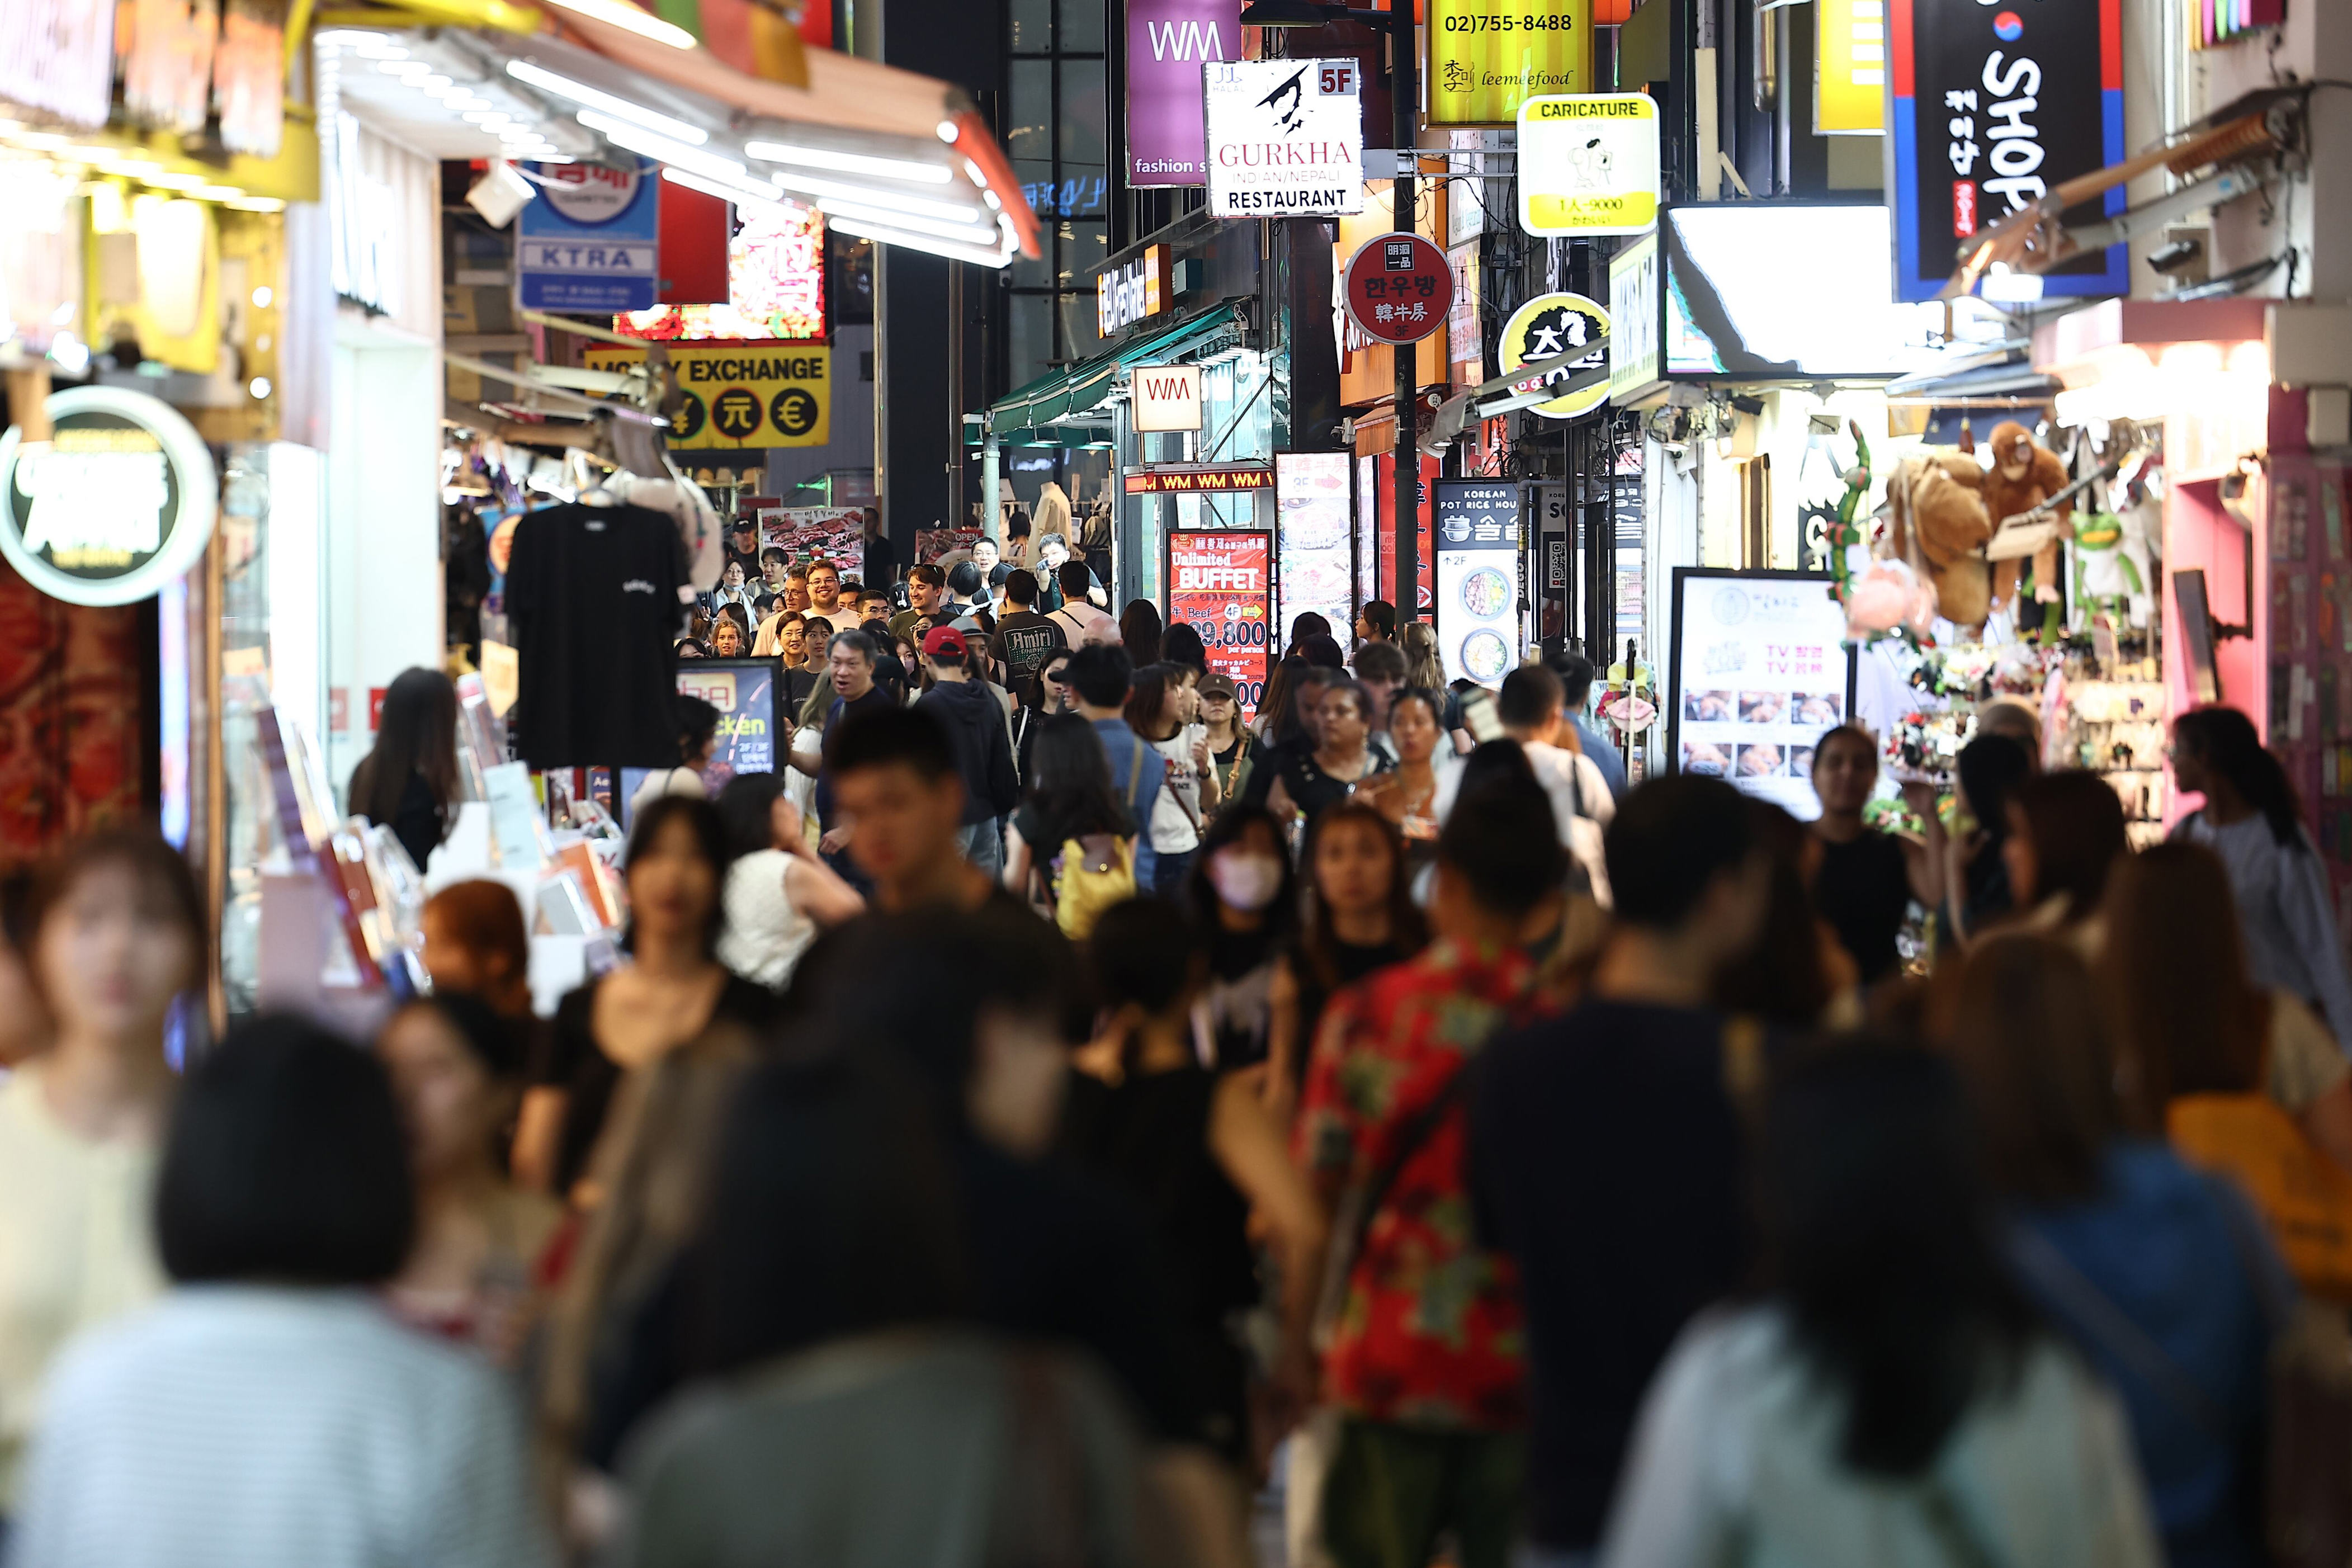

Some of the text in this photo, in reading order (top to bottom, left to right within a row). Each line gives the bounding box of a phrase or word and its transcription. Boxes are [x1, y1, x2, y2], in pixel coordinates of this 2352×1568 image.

[1444, 15, 1572, 34] 02)755-8488
[1147, 20, 1224, 62] WM
[1320, 69, 1351, 93] 5F
[1482, 70, 1574, 89] leemeefood
[1541, 102, 1638, 117] CARICATURE
[1220, 141, 1352, 167] GURKHA
[1135, 158, 1193, 173] fashion
[1229, 190, 1346, 209] RESTAURANT
[542, 247, 631, 267] KTRA
[1387, 244, 1410, 256] 明洞
[1388, 256, 1411, 268] 一品
[1364, 275, 1437, 299] 한우방
[1375, 301, 1428, 323] 韓牛房
[1395, 325, 1409, 336] 3F
[690, 357, 823, 381] EXCHANGE
[1146, 377, 1190, 400] WM
[1163, 475, 1191, 490] WM
[1197, 474, 1226, 488] WM
[1231, 472, 1260, 487] WM
[1464, 490, 1506, 498] KOREAN
[1441, 501, 1461, 509] POT
[1466, 501, 1490, 509] RICE
[1172, 552, 1231, 566] Unlimited
[1454, 556, 1466, 565] 2F
[1179, 568, 1259, 589] BUFFET
[1188, 607, 1211, 618] Beef
[1226, 607, 1239, 616] 4F
[1011, 630, 1050, 650] Amiri
[714, 715, 766, 736] cken
